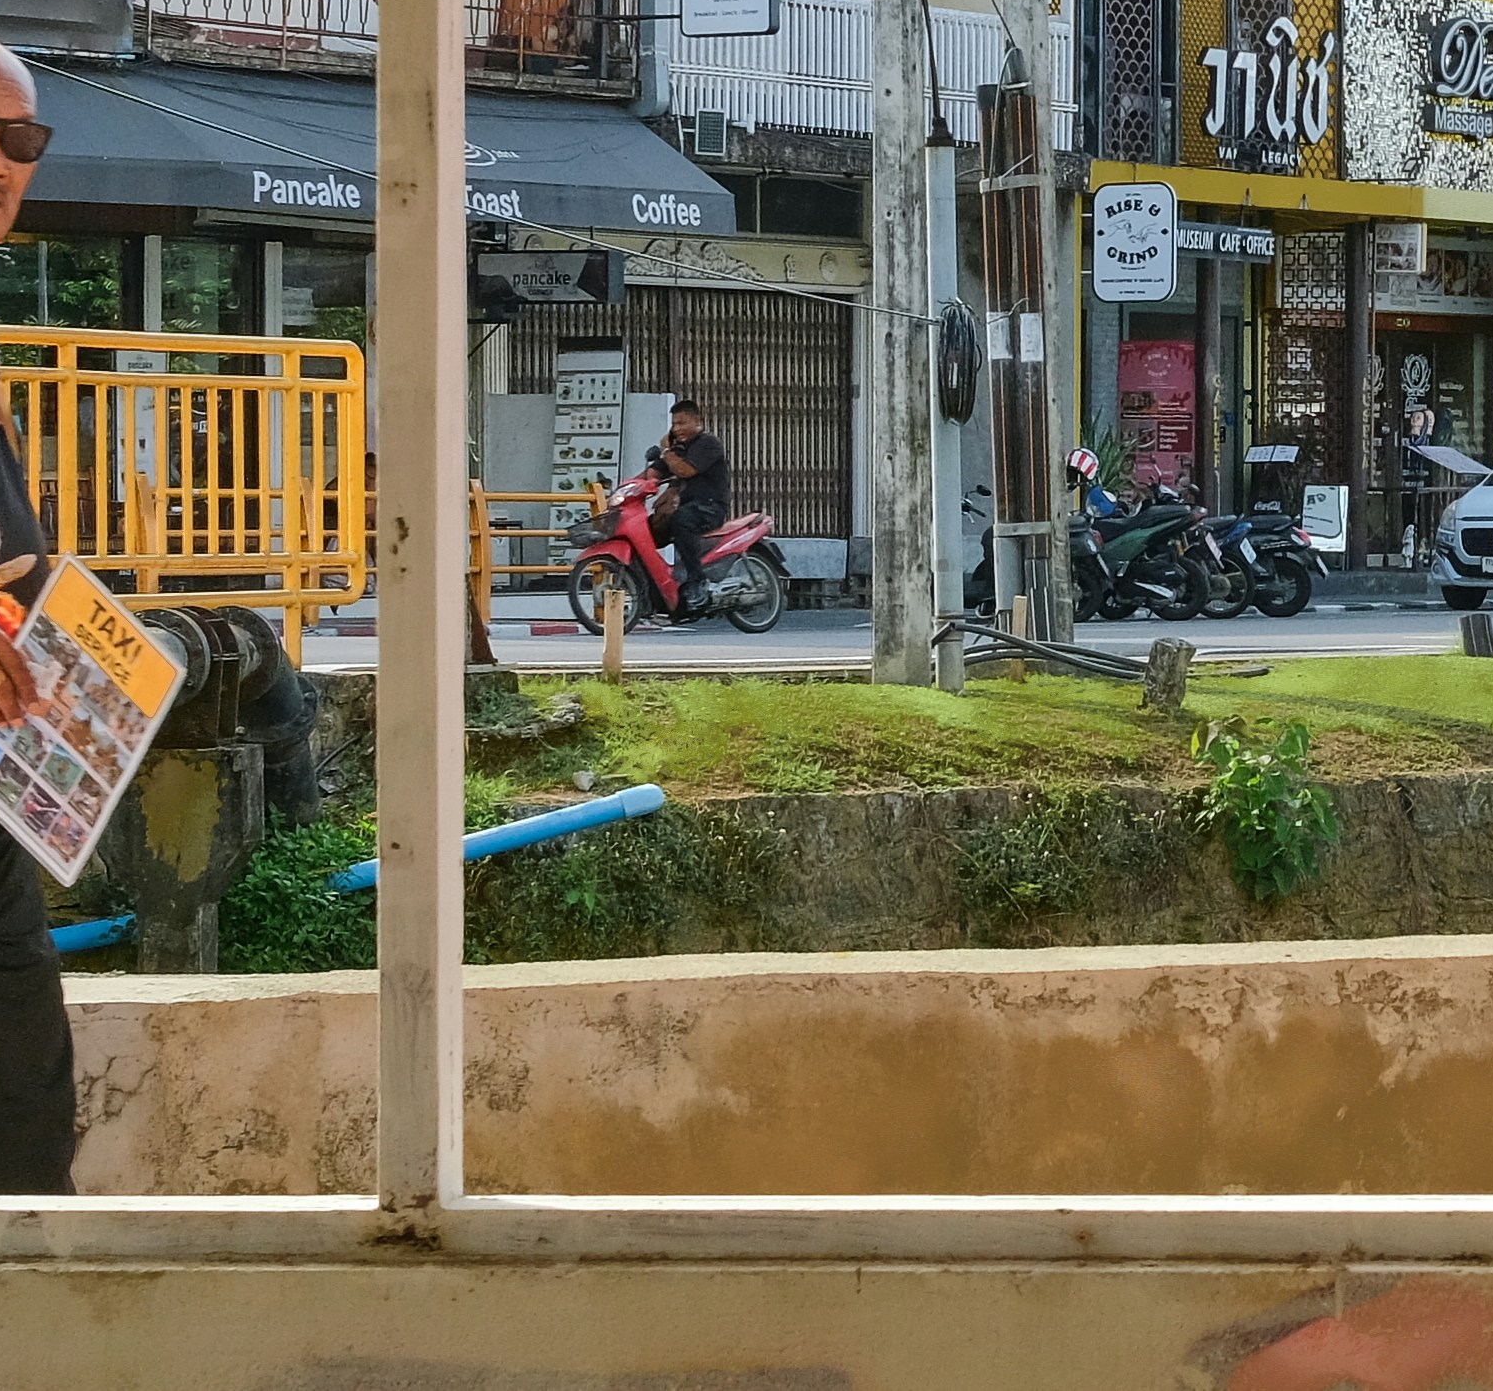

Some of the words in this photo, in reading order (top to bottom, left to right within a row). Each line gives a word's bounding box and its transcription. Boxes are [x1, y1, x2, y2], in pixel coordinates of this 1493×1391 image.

[1202, 16, 1335, 145] วานิช
[1434, 104, 1493, 140] Massage
[1262, 150, 1303, 168] LEGACY
[252, 170, 362, 208] Pancake
[632, 193, 702, 227] Coffee
[1104, 199, 1144, 219] RISE
[1148, 203, 1162, 217] &
[1176, 228, 1214, 251] MUSEUM
[1107, 246, 1159, 265] GRIND
[512, 270, 572, 288] pancake
[91, 598, 143, 664] TAXI
